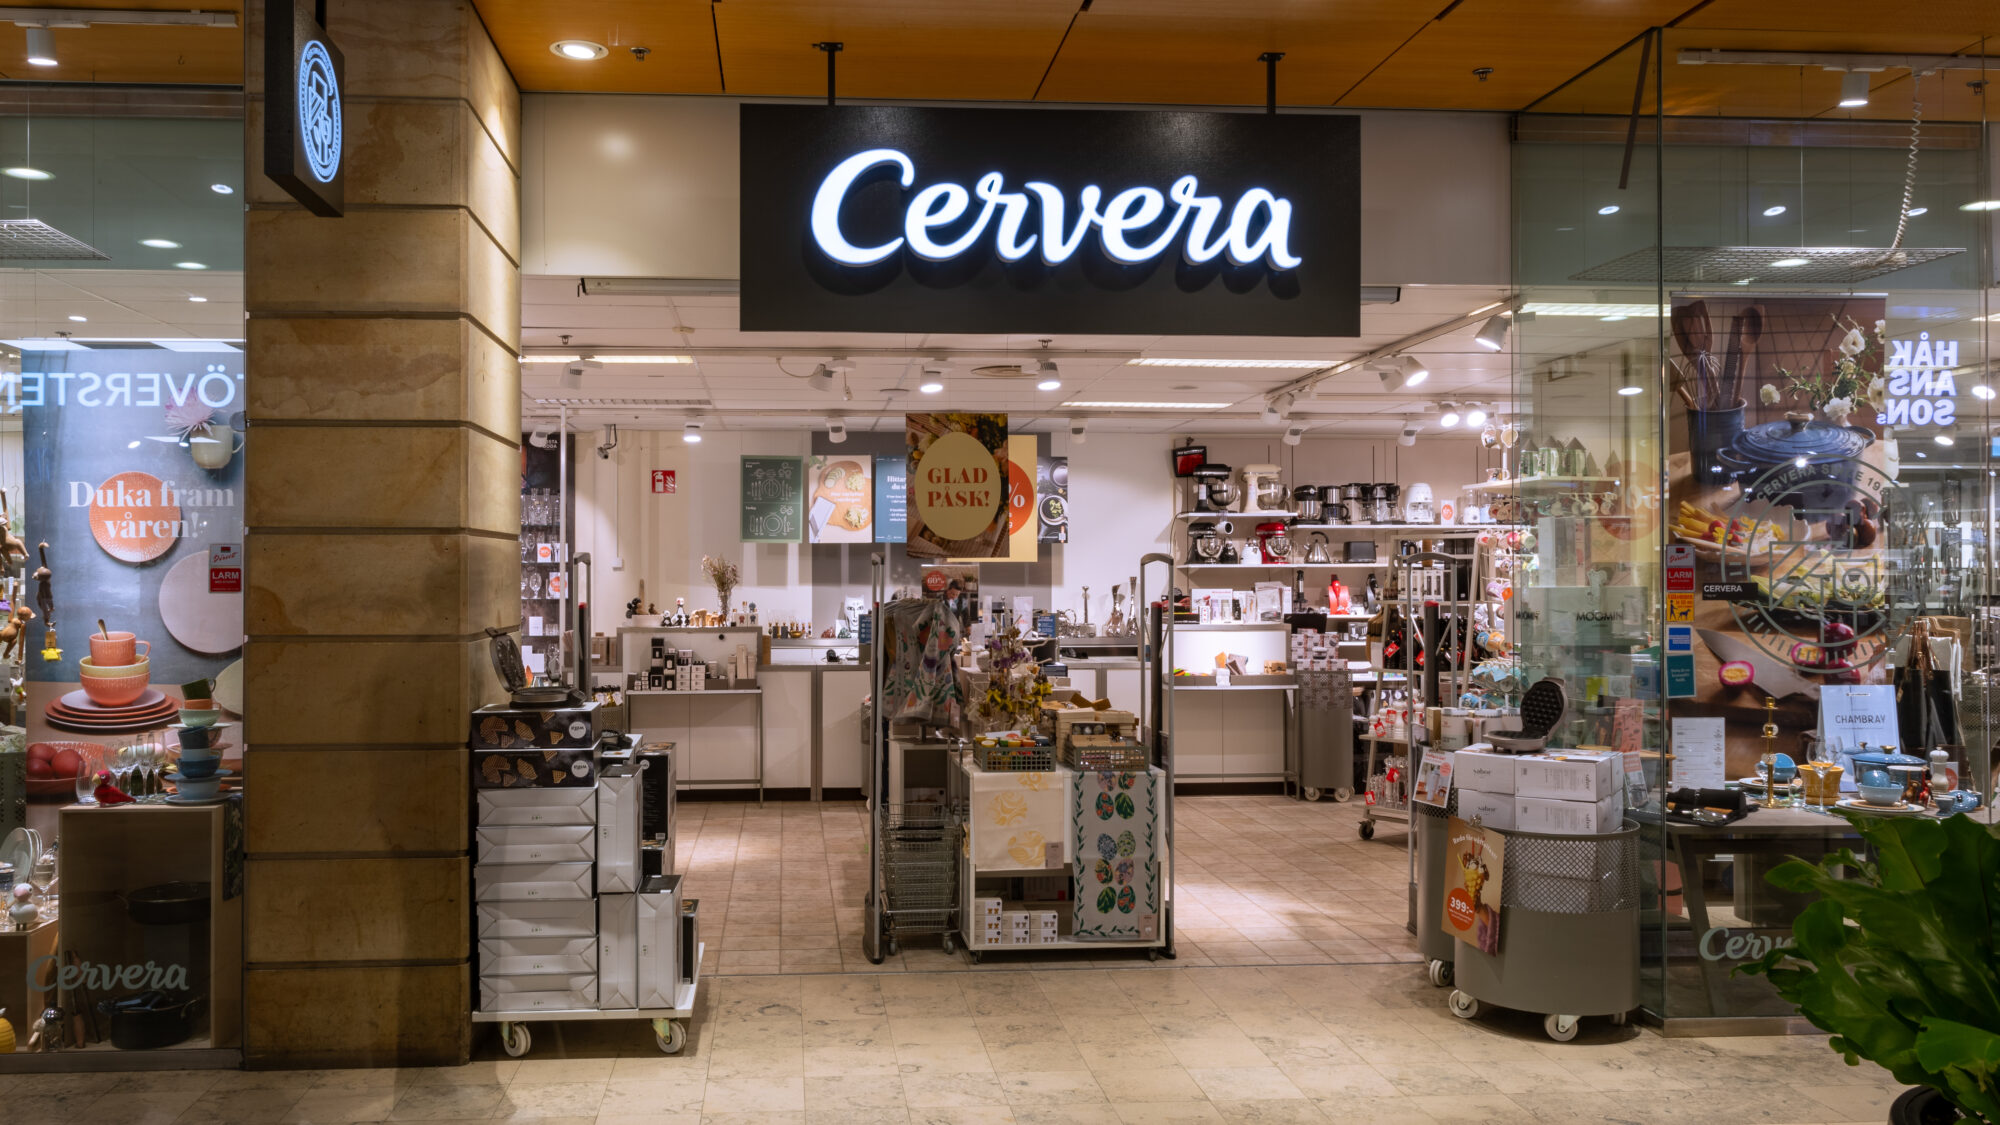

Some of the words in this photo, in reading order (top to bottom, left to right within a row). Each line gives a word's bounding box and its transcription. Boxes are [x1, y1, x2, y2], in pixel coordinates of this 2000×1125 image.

[811, 148, 1301, 270] Cervera
[928, 467, 989, 485] GLAD
[1756, 463, 1817, 501] CERVERA
[68, 481, 151, 508] Duka
[161, 480, 234, 508] fram
[928, 486, 991, 508] PÅSK!
[105, 511, 200, 540] våren!
[212, 571, 239, 580] LARM
[1668, 571, 1693, 579] LARM
[1703, 584, 1743, 593] CERVERA
[1576, 610, 1624, 622] MOOMIN
[1835, 714, 1886, 724] CHAMBRAY
[1450, 896, 1473, 913] 399:-
[26, 954, 190, 993] Cervera
